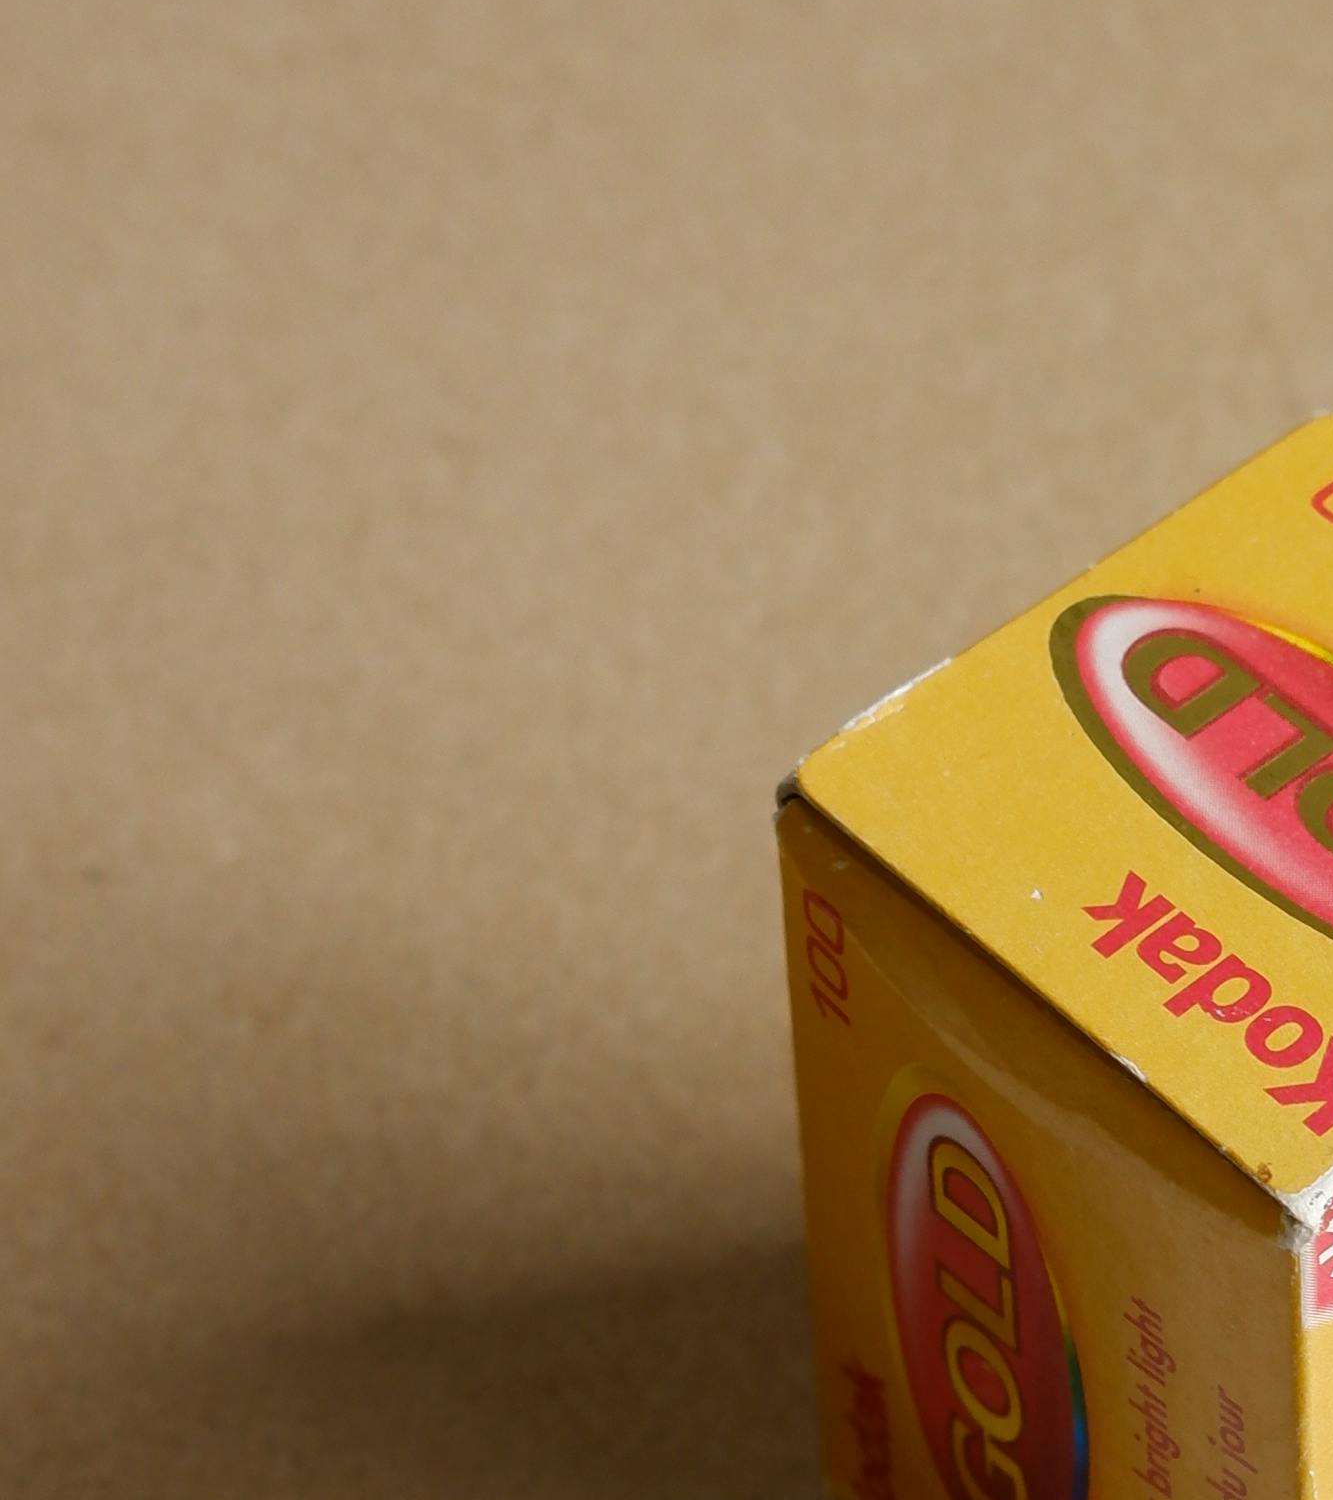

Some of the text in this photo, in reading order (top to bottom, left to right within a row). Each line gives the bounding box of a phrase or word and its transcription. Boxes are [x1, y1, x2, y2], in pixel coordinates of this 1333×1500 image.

[804, 890, 850, 1027] 100
[1123, 1295, 1177, 1388] light
[1128, 1380, 1180, 1498] bright
[1207, 1383, 1258, 1474] jour
